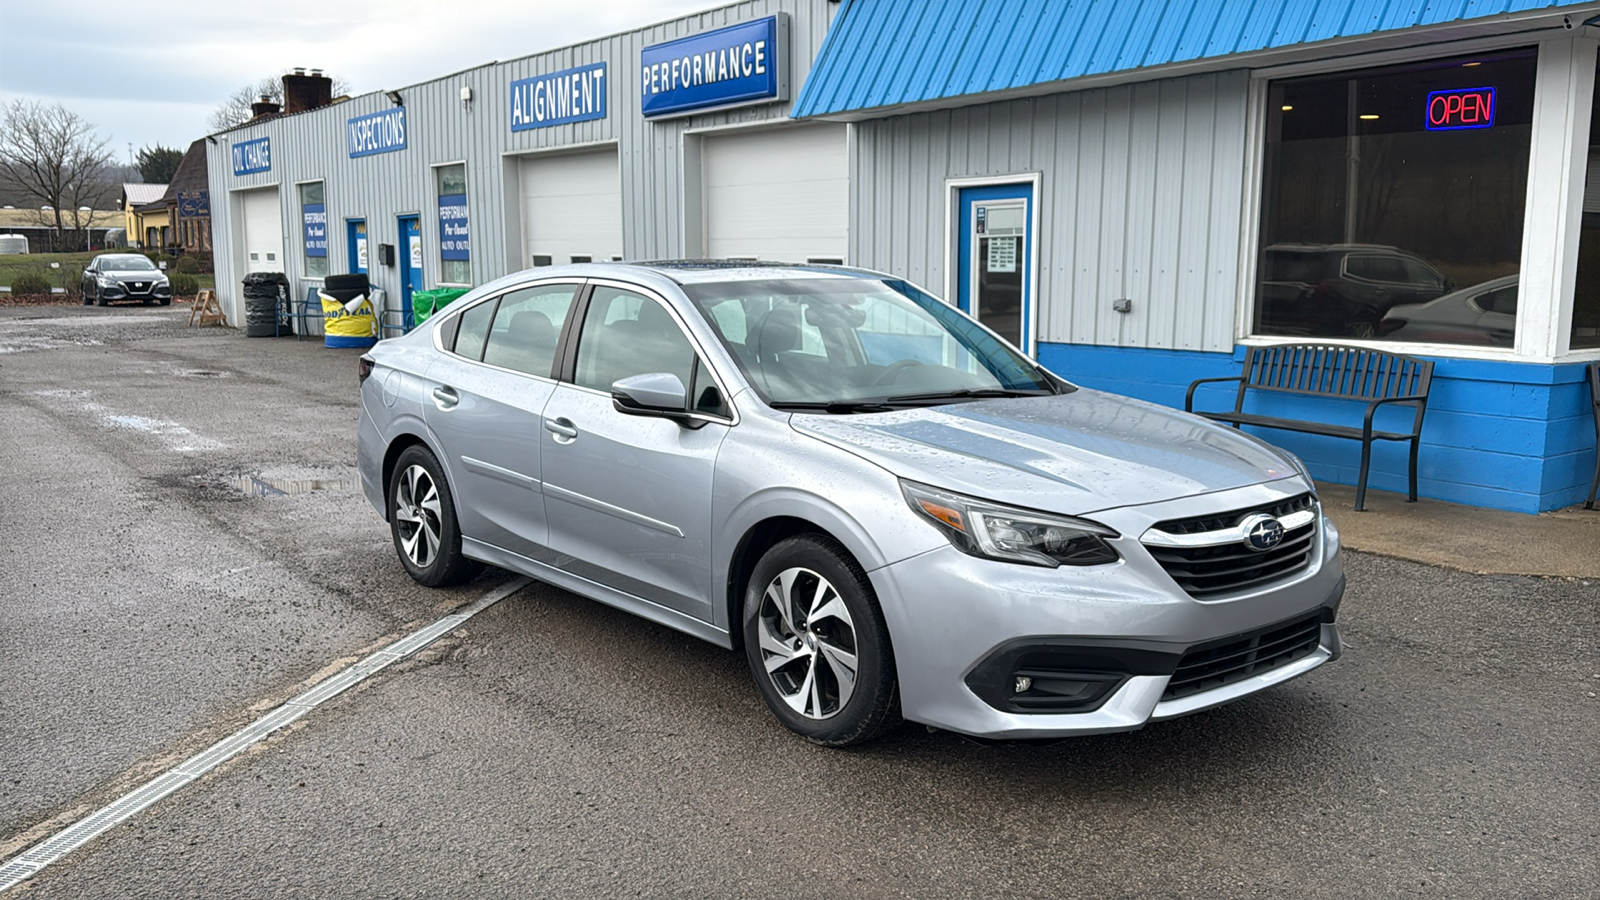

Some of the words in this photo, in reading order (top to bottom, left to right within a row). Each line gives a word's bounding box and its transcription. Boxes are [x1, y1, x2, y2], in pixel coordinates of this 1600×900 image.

[643, 41, 765, 96] PERFORMANCE
[512, 69, 604, 126] ALIGNMENT
[1429, 92, 1492, 125] OPEN
[349, 111, 404, 154] INSPECTIONS
[234, 147, 245, 172] OIL
[245, 140, 269, 170] CHANGE
[442, 240, 455, 251] AUTO
